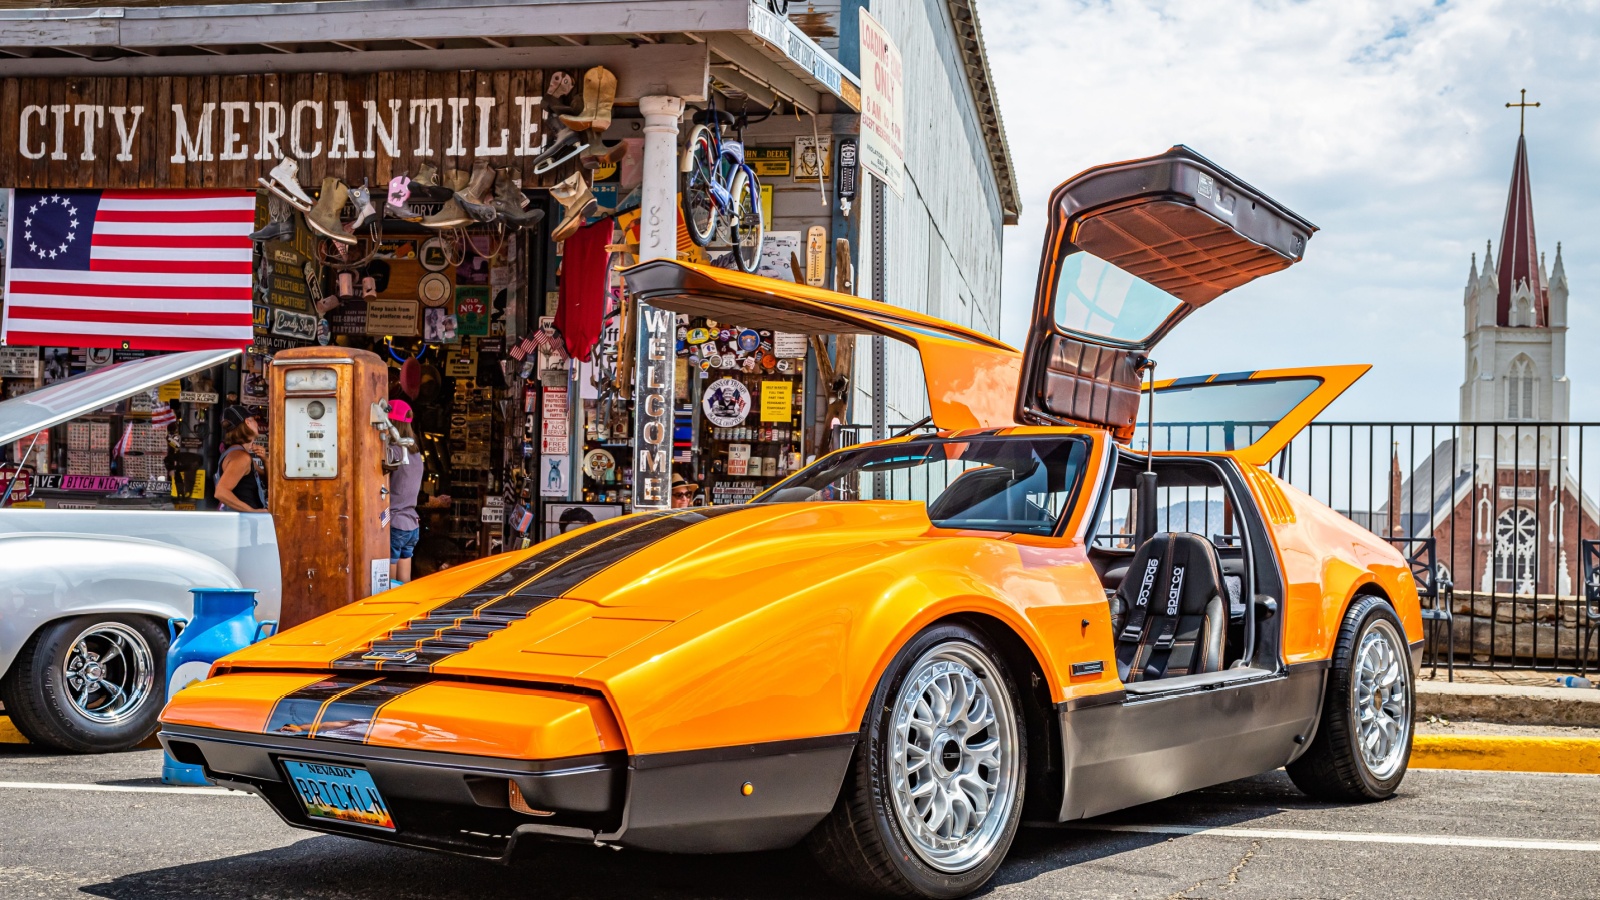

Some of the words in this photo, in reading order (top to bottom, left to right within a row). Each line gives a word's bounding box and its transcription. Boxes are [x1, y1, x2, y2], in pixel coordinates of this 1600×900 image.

[862, 20, 888, 65] LOADING
[874, 61, 894, 106] ONLY
[866, 96, 871, 112] 8
[872, 104, 882, 122] AM
[19, 104, 144, 162] CITY
[171, 96, 547, 163] MERCANTILE
[744, 150, 757, 158] OHN
[767, 150, 788, 158] DEERE
[277, 314, 298, 332] Candy
[299, 318, 314, 335] Shop
[254, 336, 272, 348] RGINIA
[274, 339, 287, 348] CITY
[288, 341, 296, 349] NV
[640, 310, 668, 501] WELCOME
[67, 476, 94, 489] BITCH
[156, 481, 171, 491] GARA
[1136, 558, 1158, 606] sparco
[1167, 566, 1184, 615] sparco
[306, 764, 352, 778] NEVADA
[296, 777, 386, 816] BRICKLN
